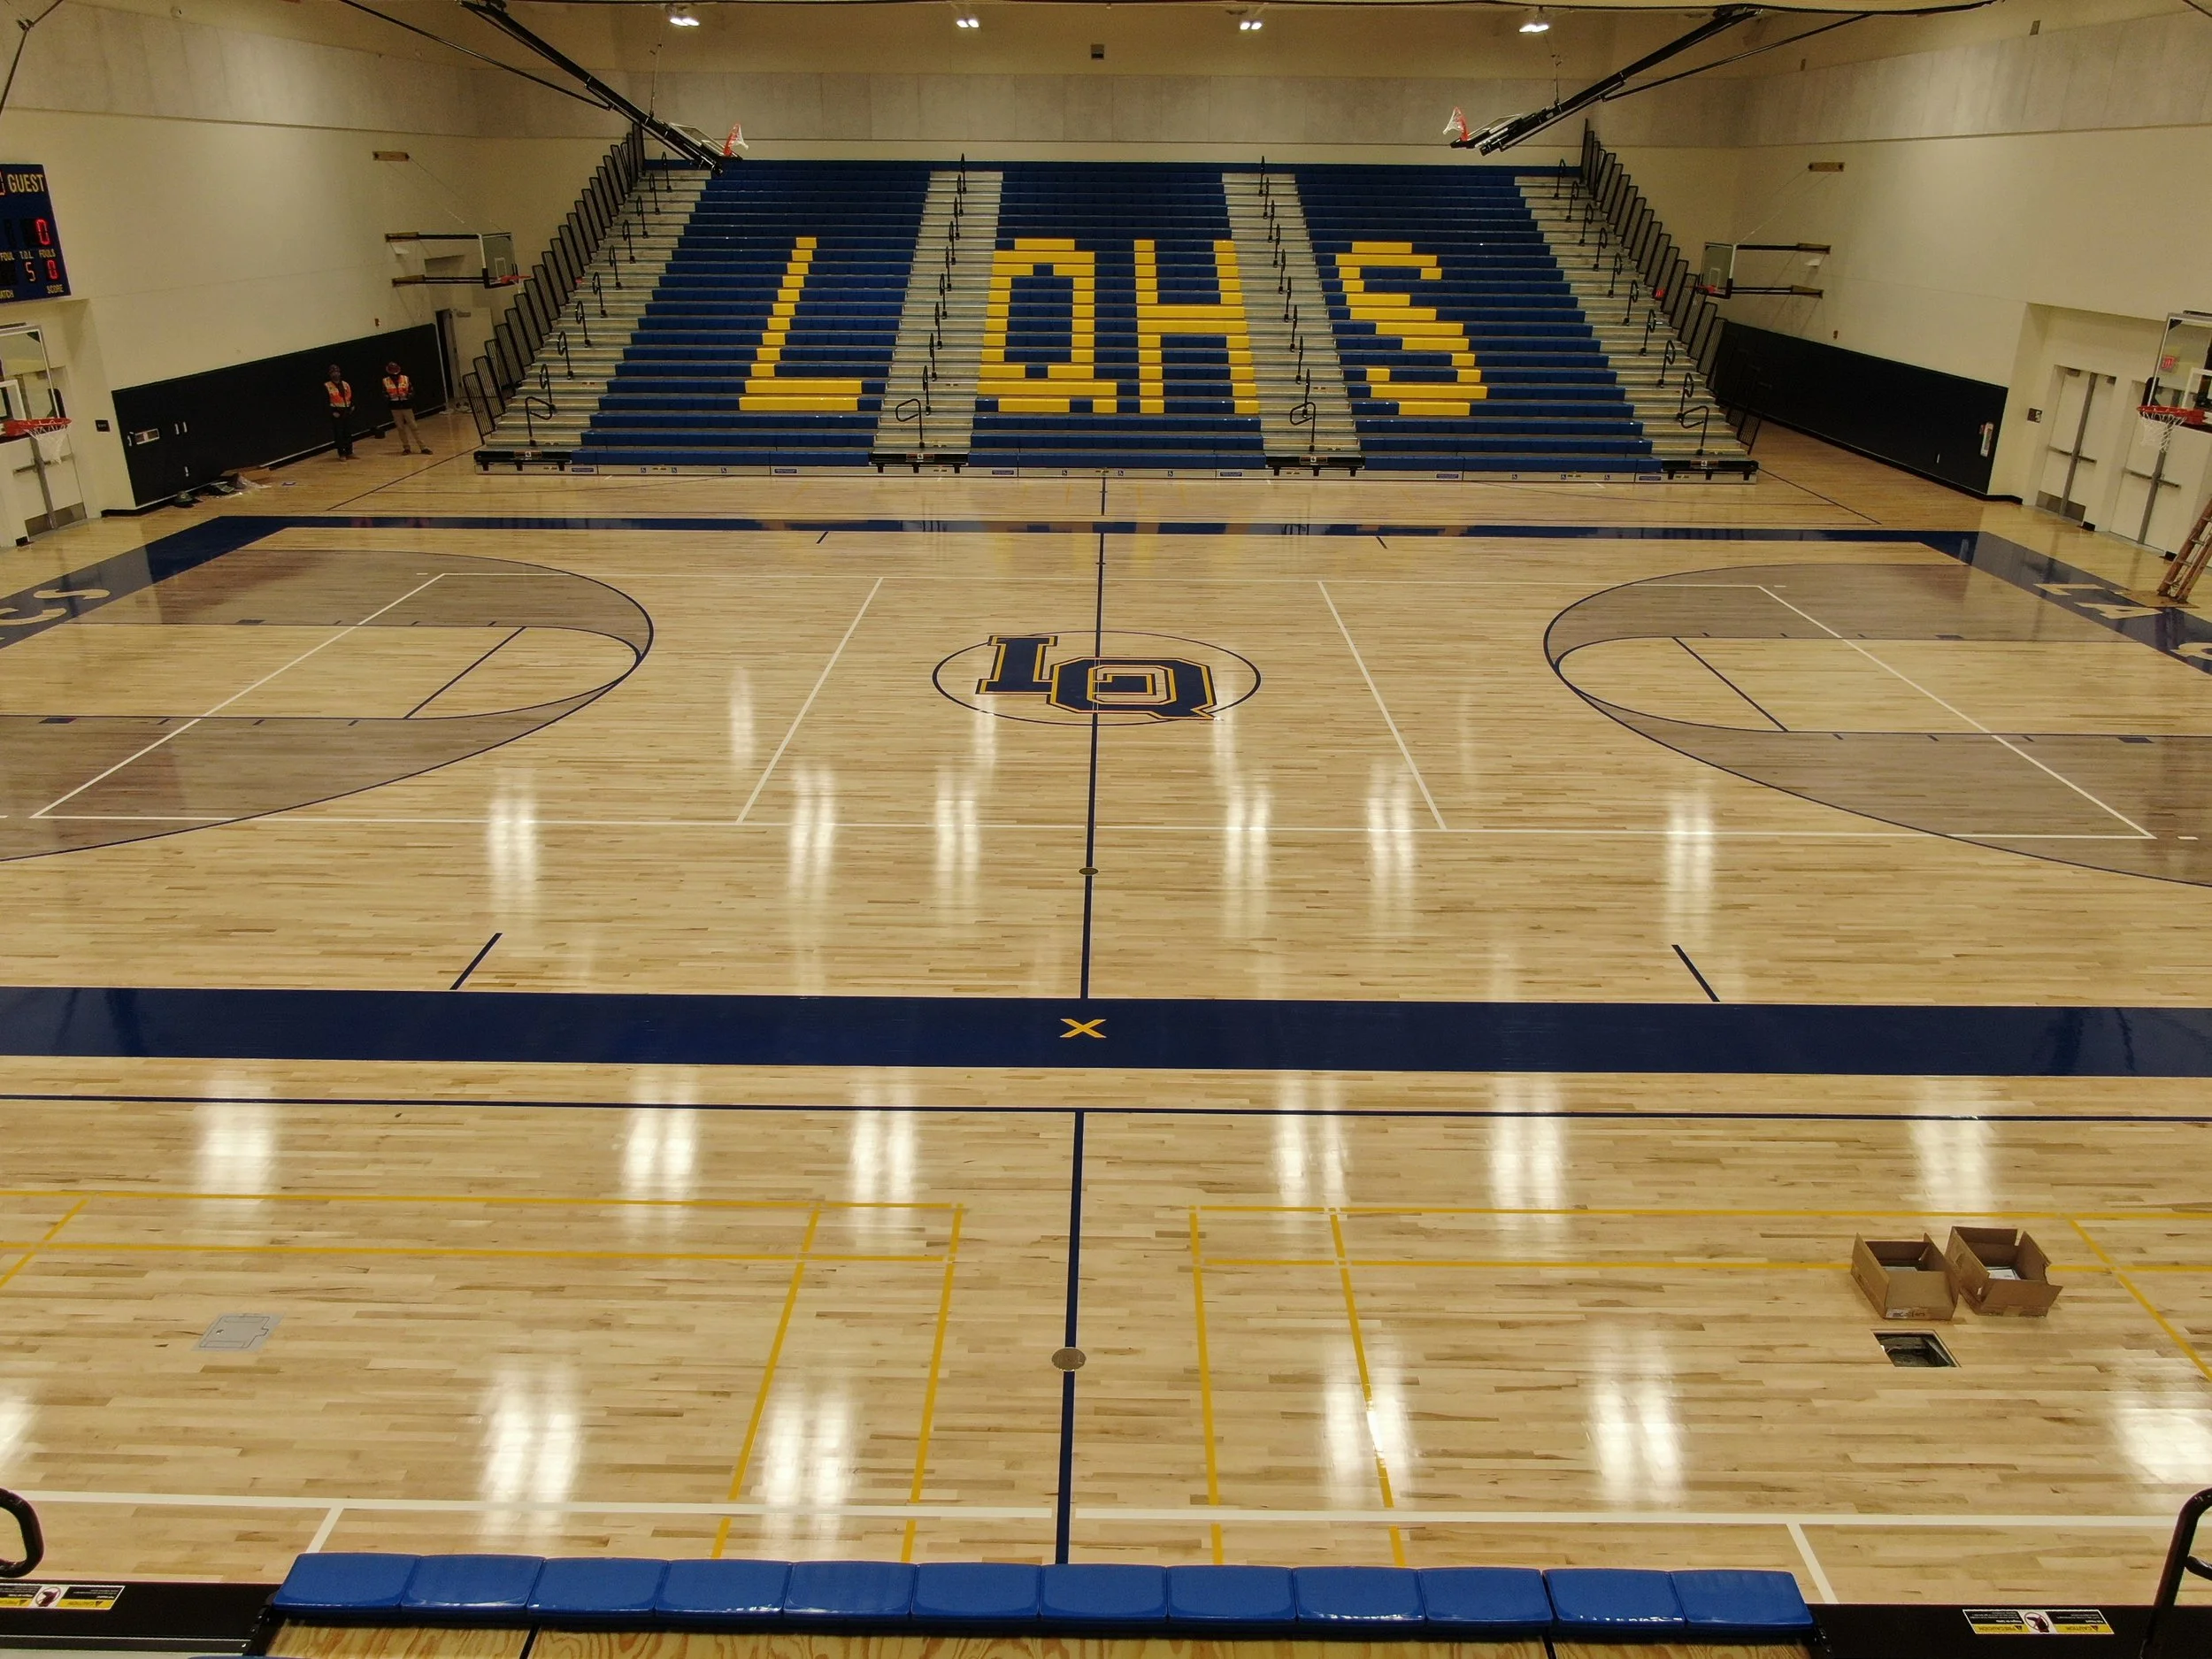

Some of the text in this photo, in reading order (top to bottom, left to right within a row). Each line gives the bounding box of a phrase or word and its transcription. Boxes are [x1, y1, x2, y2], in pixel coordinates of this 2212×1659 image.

[7, 173, 44, 193] GUEST
[35, 219, 50, 245] 0
[25, 259, 58, 282] 5 0
[975, 634, 1217, 720] LQ
